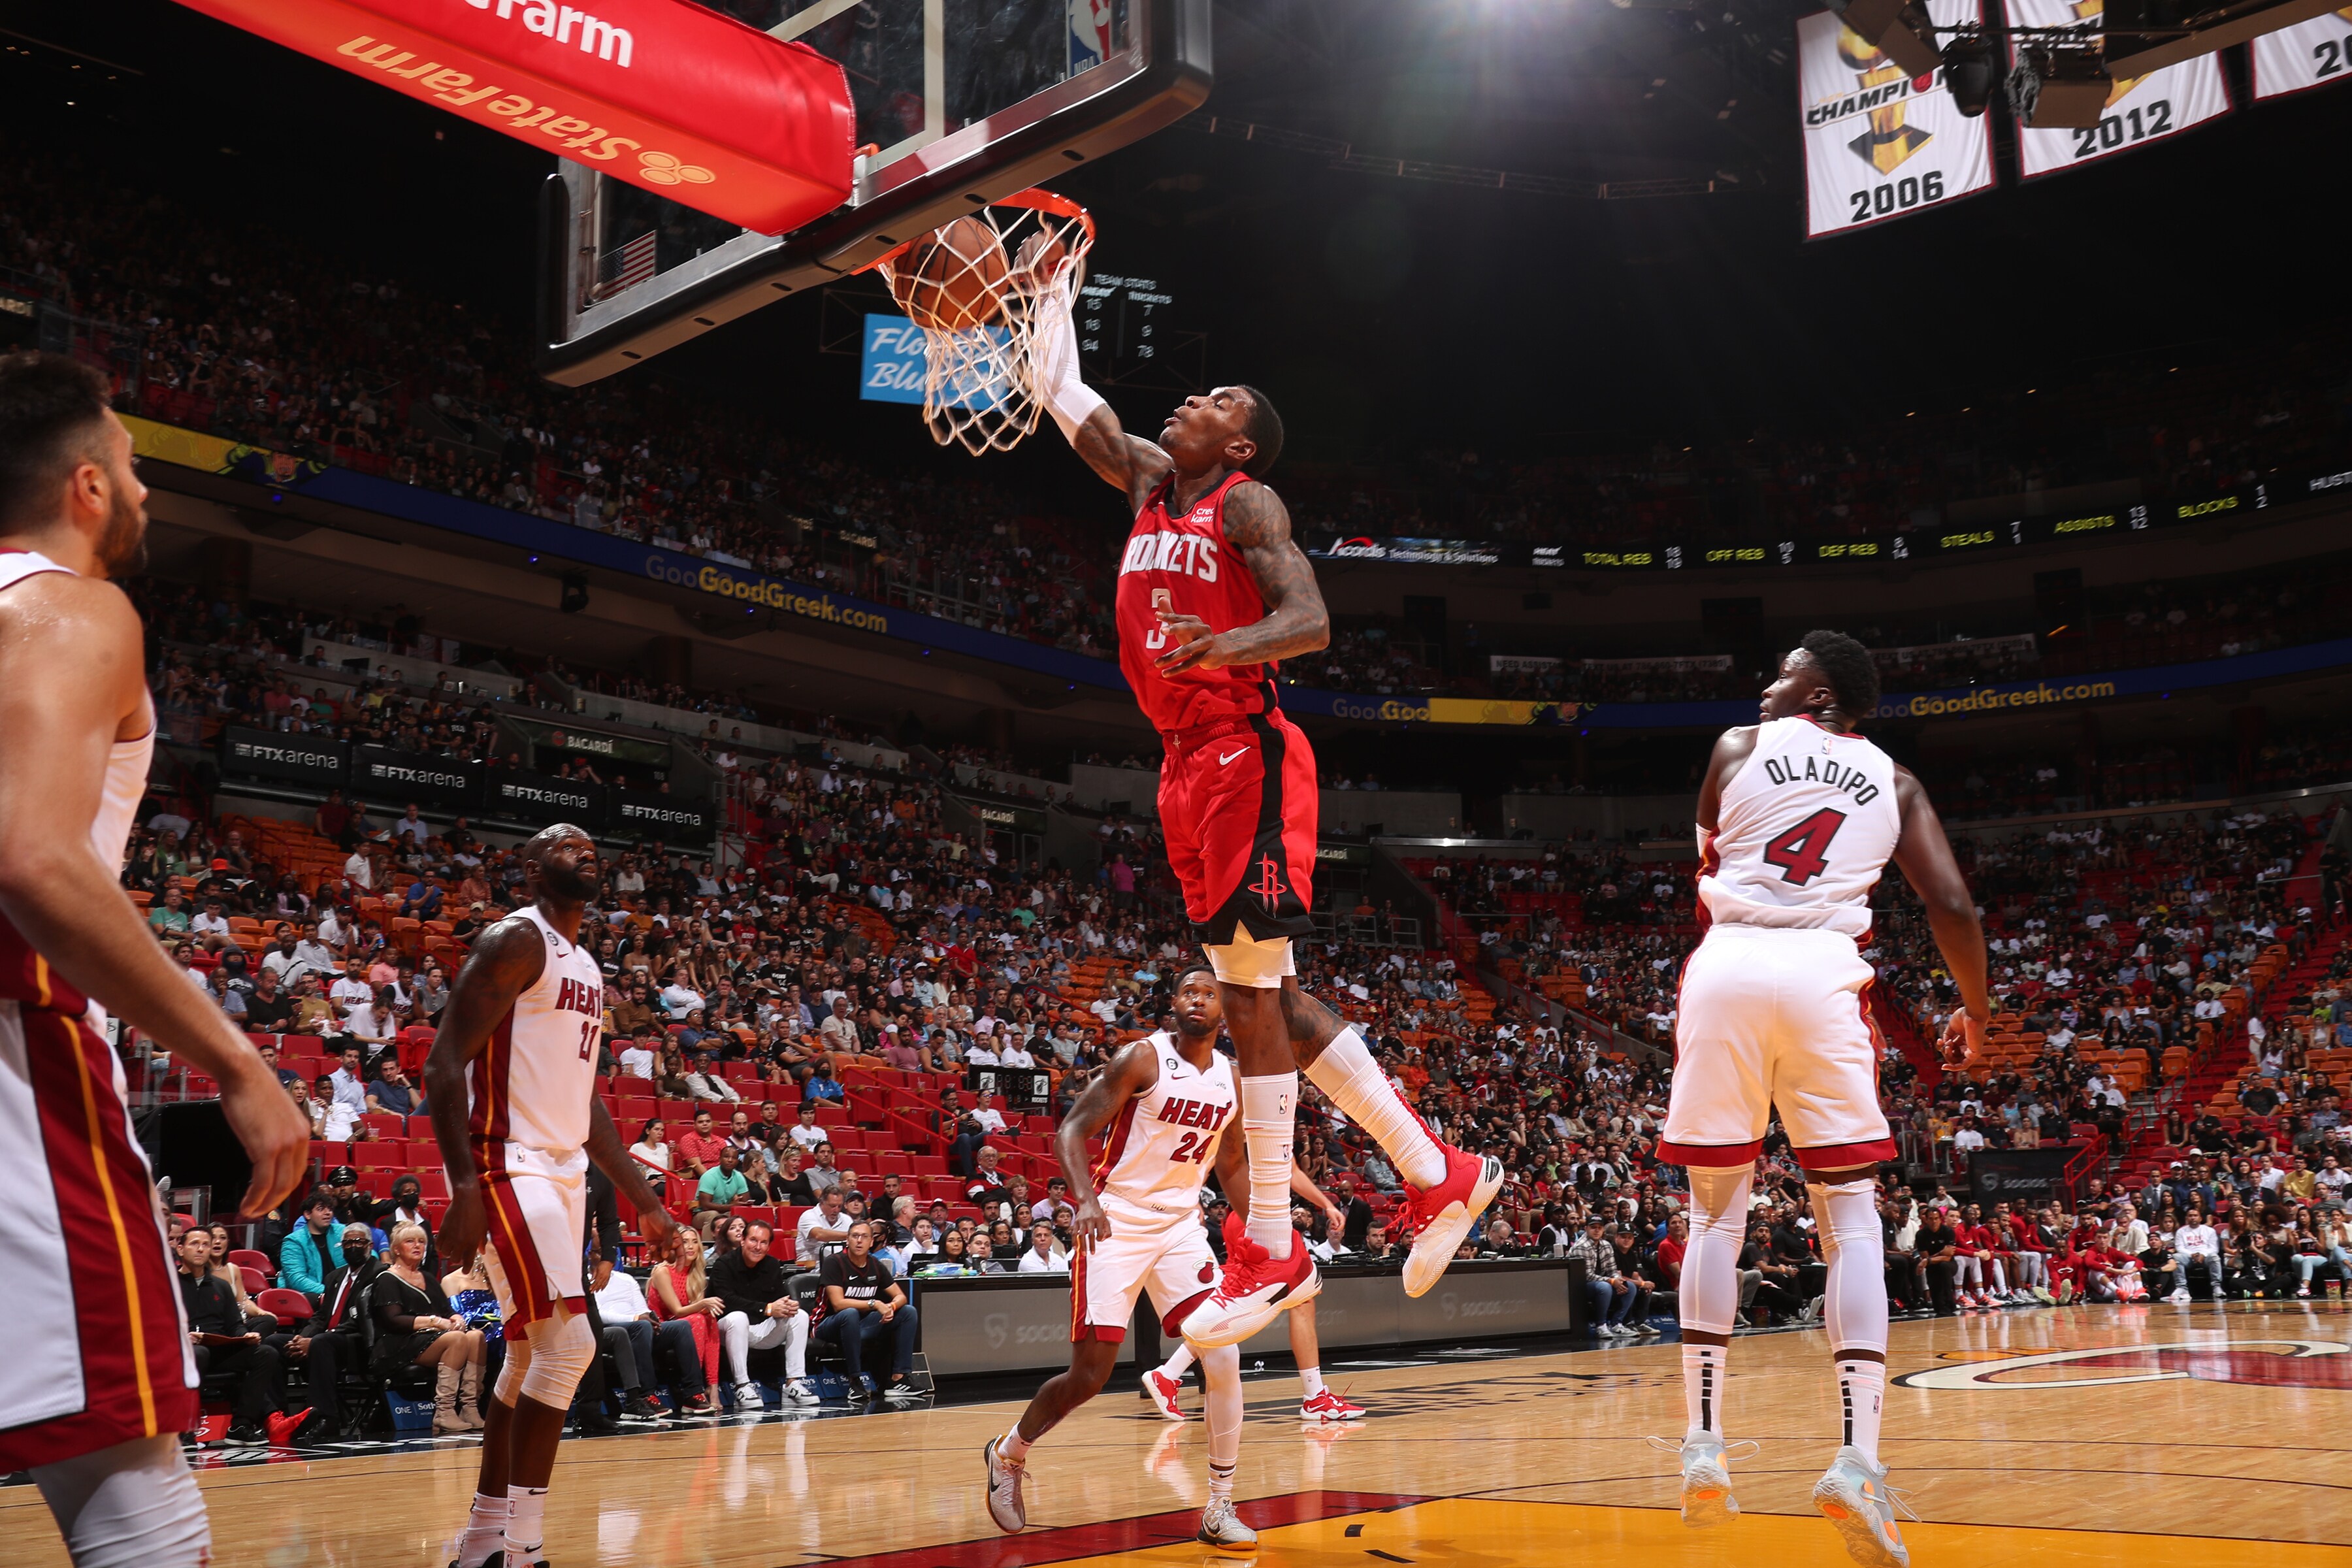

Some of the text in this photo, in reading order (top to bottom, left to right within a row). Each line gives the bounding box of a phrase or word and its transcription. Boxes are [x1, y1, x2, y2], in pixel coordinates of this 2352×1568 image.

[2074, 100, 2172, 158] 2012
[1850, 171, 1944, 223] 2006
[1093, 274, 1156, 291] TEAM STATS
[1143, 304, 1154, 316] 7
[2255, 483, 2265, 497] 1
[2128, 504, 2148, 518] 13
[2178, 495, 2240, 519] BLOCKS
[2255, 495, 2268, 510] 2
[2009, 521, 2022, 534] 7
[2053, 515, 2116, 534] ASSISTS
[2129, 516, 2149, 531] 12
[1940, 530, 1995, 548] STEALS
[2012, 532, 2022, 545] 1
[1582, 551, 1653, 566] TOTAL REB
[1706, 547, 1766, 562] OFF REB
[1819, 543, 1879, 557] DEF REB
[698, 566, 888, 633] GoodGreek.com
[1909, 681, 2115, 717] GoodGreek.com
[568, 735, 613, 753] BACARDÍ
[1764, 755, 1879, 806] OLADIPO
[981, 808, 1015, 824] BACARDÍ
[1763, 807, 1847, 887] 4
[555, 977, 602, 1020] HEAT
[1158, 1097, 1232, 1132] HEAT
[1169, 1132, 1215, 1164] 24
[845, 1286, 878, 1298] MIAMI
